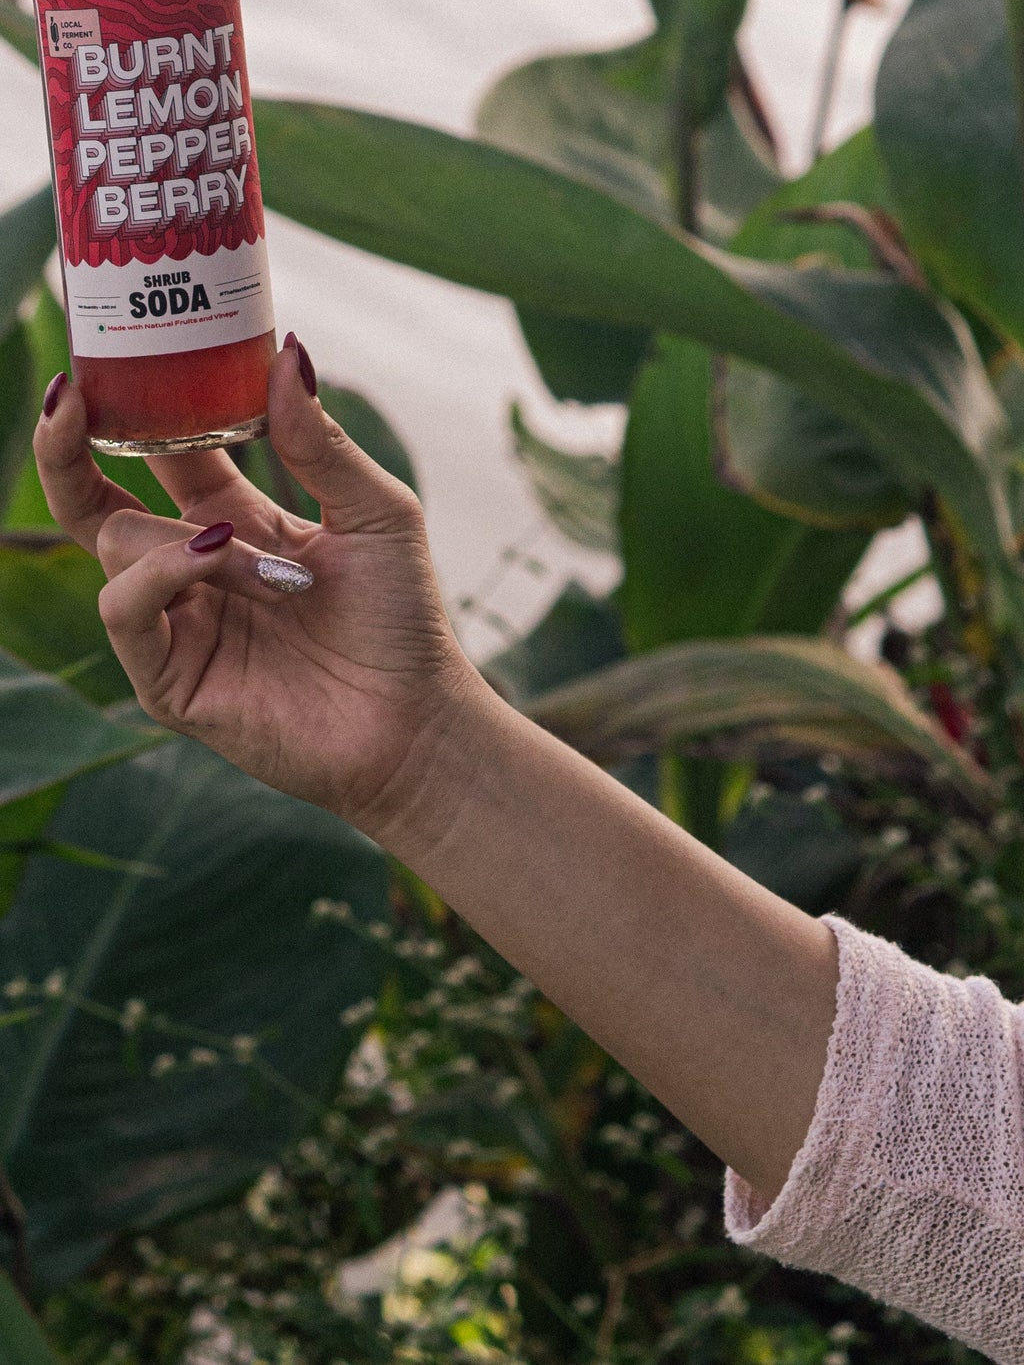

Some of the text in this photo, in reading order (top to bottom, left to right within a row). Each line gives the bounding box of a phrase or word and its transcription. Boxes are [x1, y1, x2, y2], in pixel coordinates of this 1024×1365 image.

[60, 21, 83, 29] LOCAL
[61, 30, 94, 39] FERMENT
[77, 23, 234, 83] BURNT
[78, 70, 243, 131] LEMON
[78, 116, 252, 177] PEPPER
[96, 164, 248, 224] BERRY
[143, 271, 192, 289] SHRUB
[128, 284, 212, 319] SODA
[144, 320, 174, 330] Natural
[174, 317, 198, 326] Fruits
[198, 314, 214, 324] and
[213, 309, 240, 320] Vinegar
